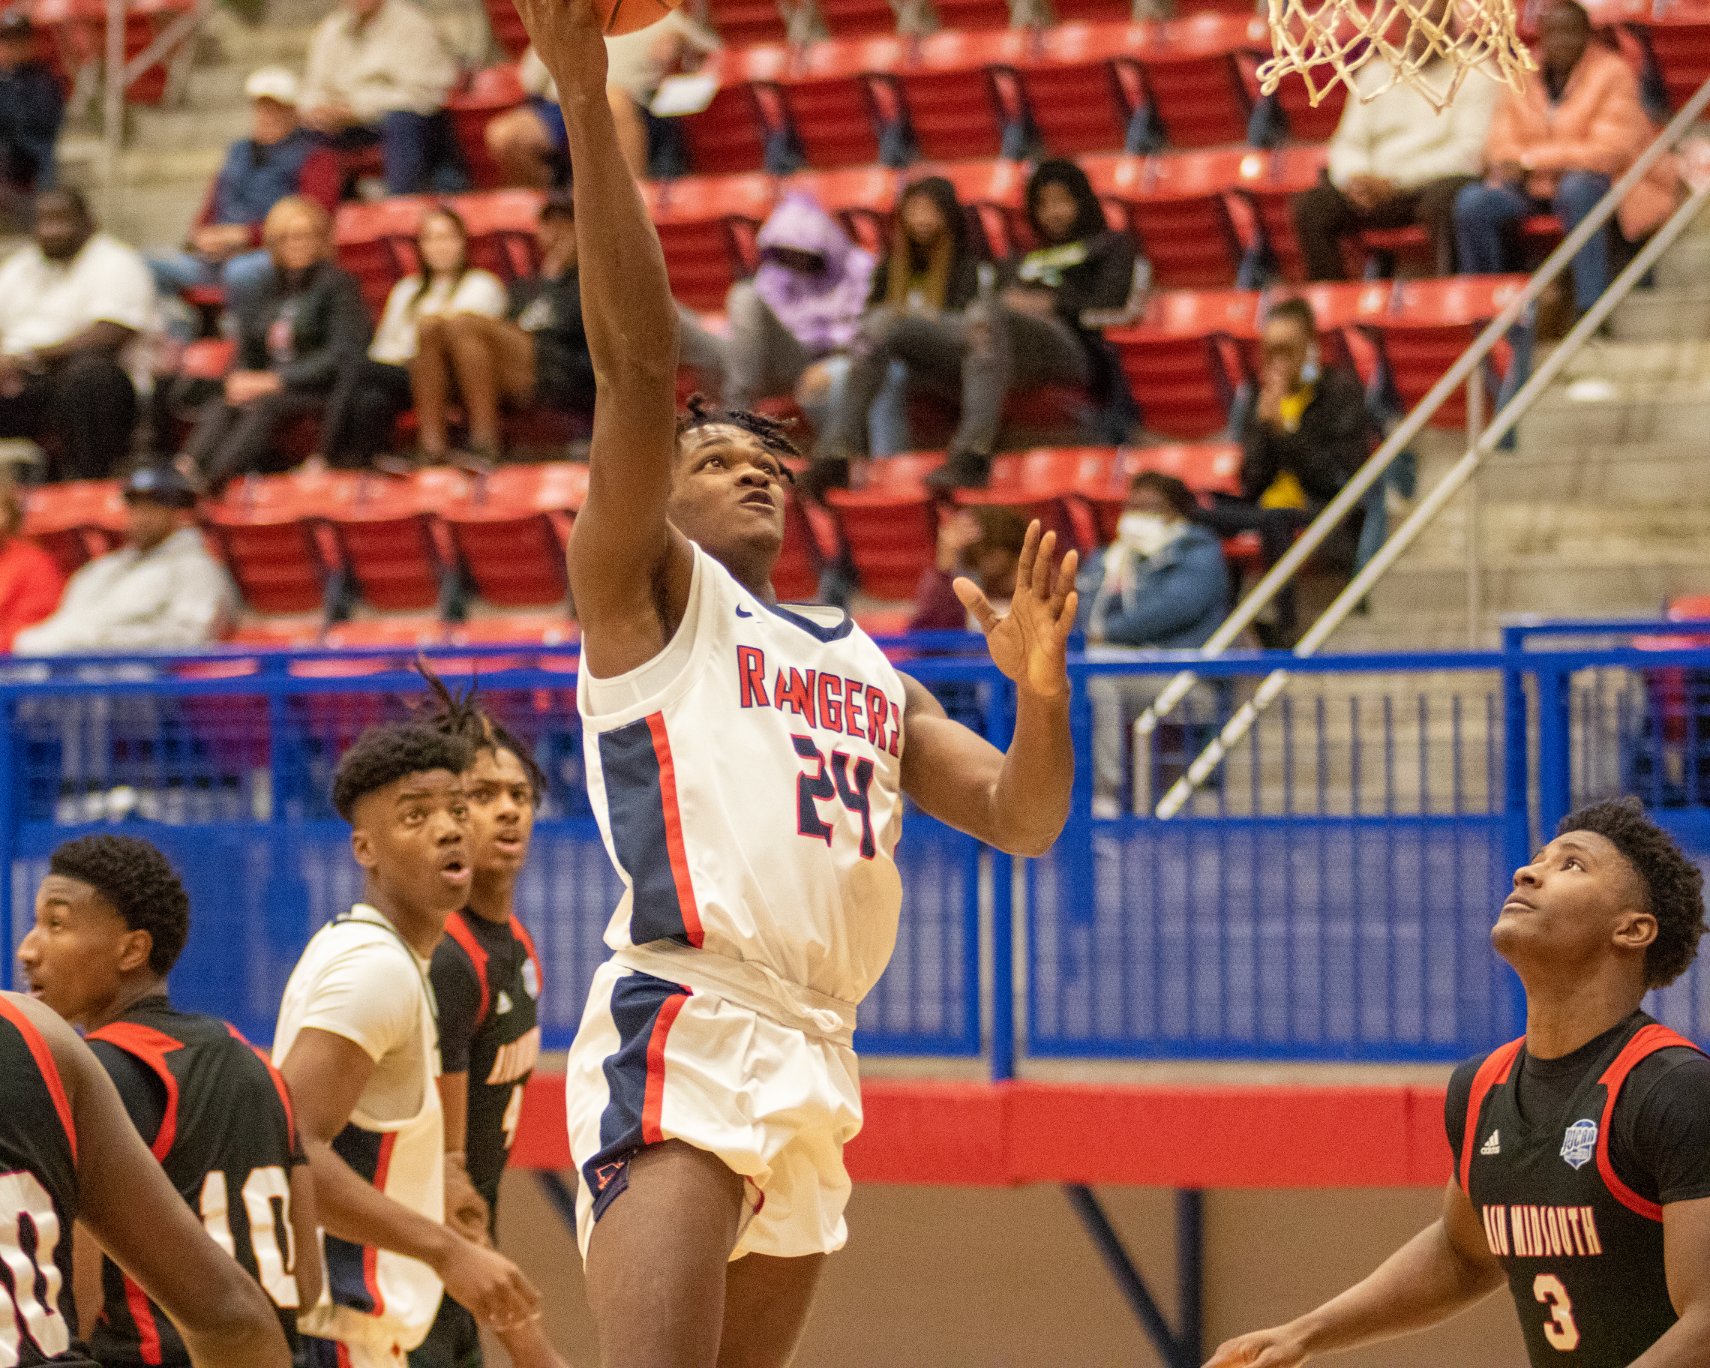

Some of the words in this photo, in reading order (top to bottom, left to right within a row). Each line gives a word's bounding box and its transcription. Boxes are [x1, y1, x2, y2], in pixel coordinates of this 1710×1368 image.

[790, 733, 875, 861] 24
[200, 1165, 298, 1309] 10
[1510, 1203, 1603, 1257] MIDSOUTH
[1533, 1273, 1581, 1351] 3
